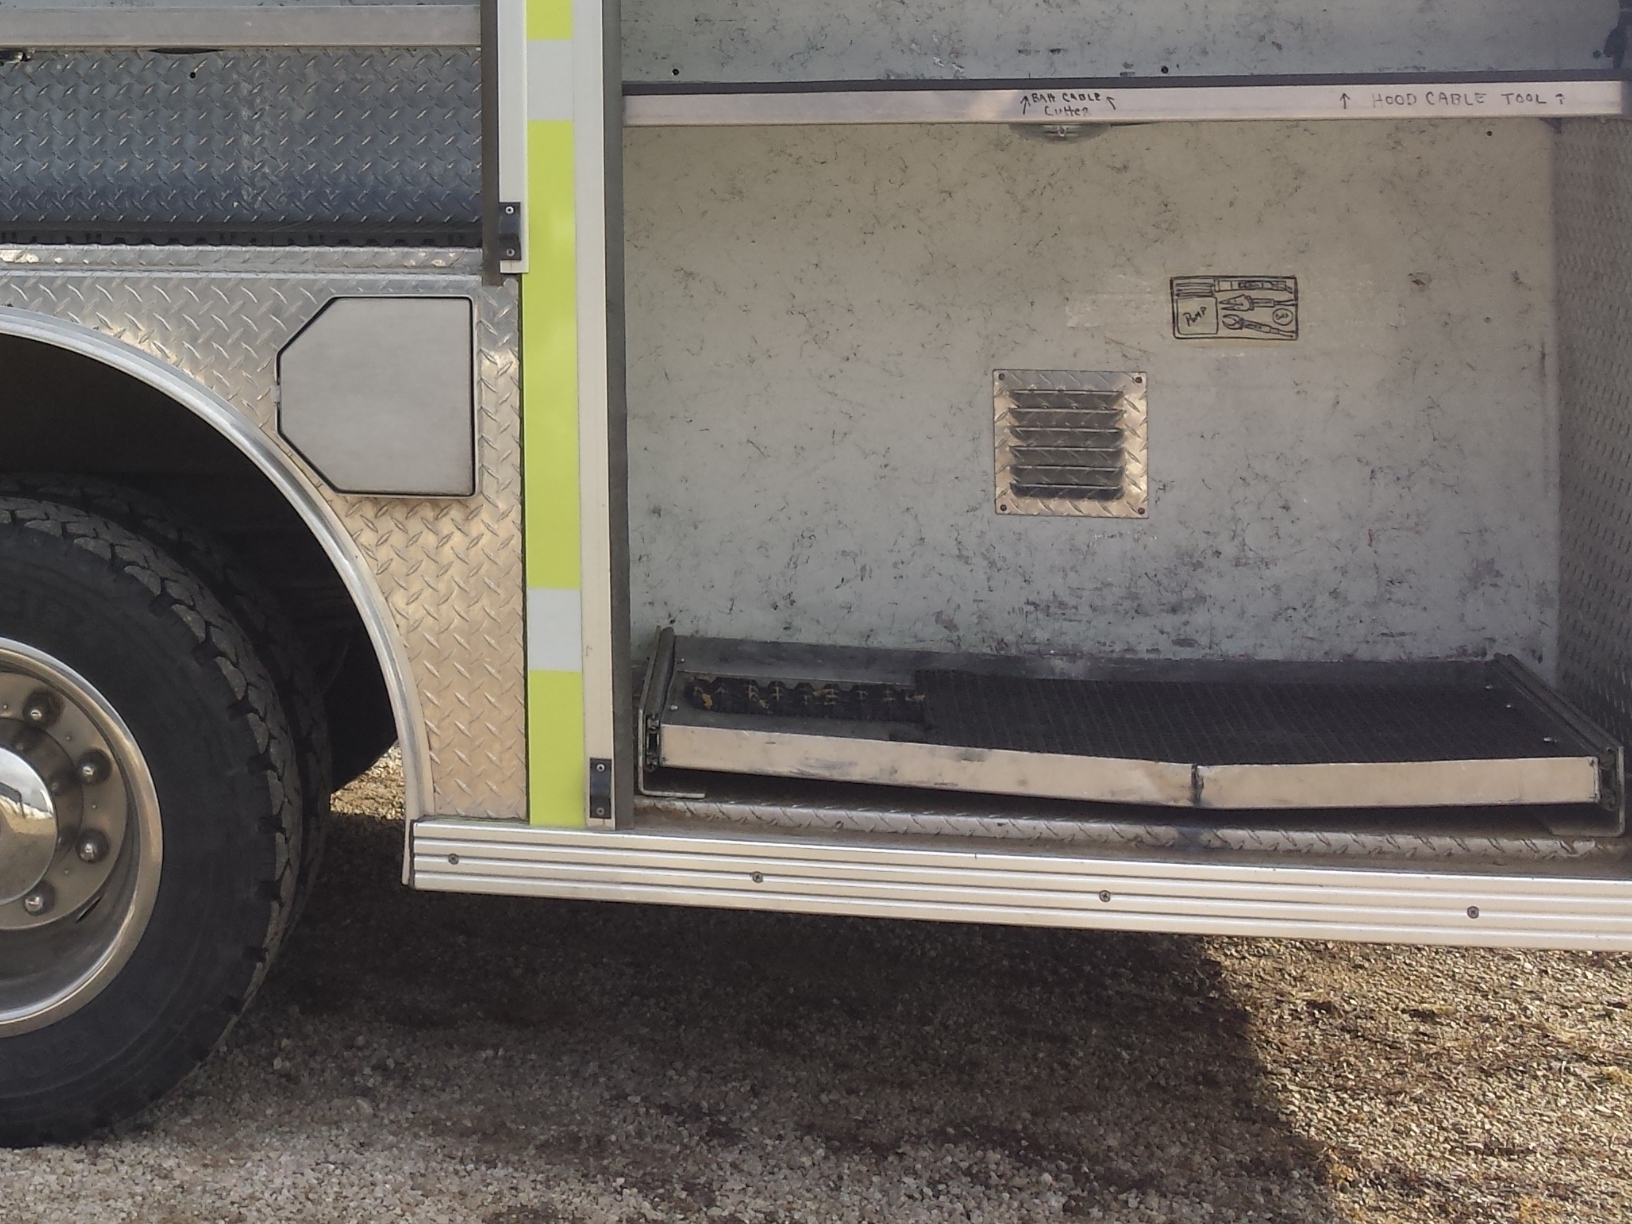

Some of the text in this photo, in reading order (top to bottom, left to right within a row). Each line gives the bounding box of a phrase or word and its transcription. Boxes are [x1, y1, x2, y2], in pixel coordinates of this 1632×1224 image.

[1372, 91, 1546, 108] HOOD CABLE TOOL
